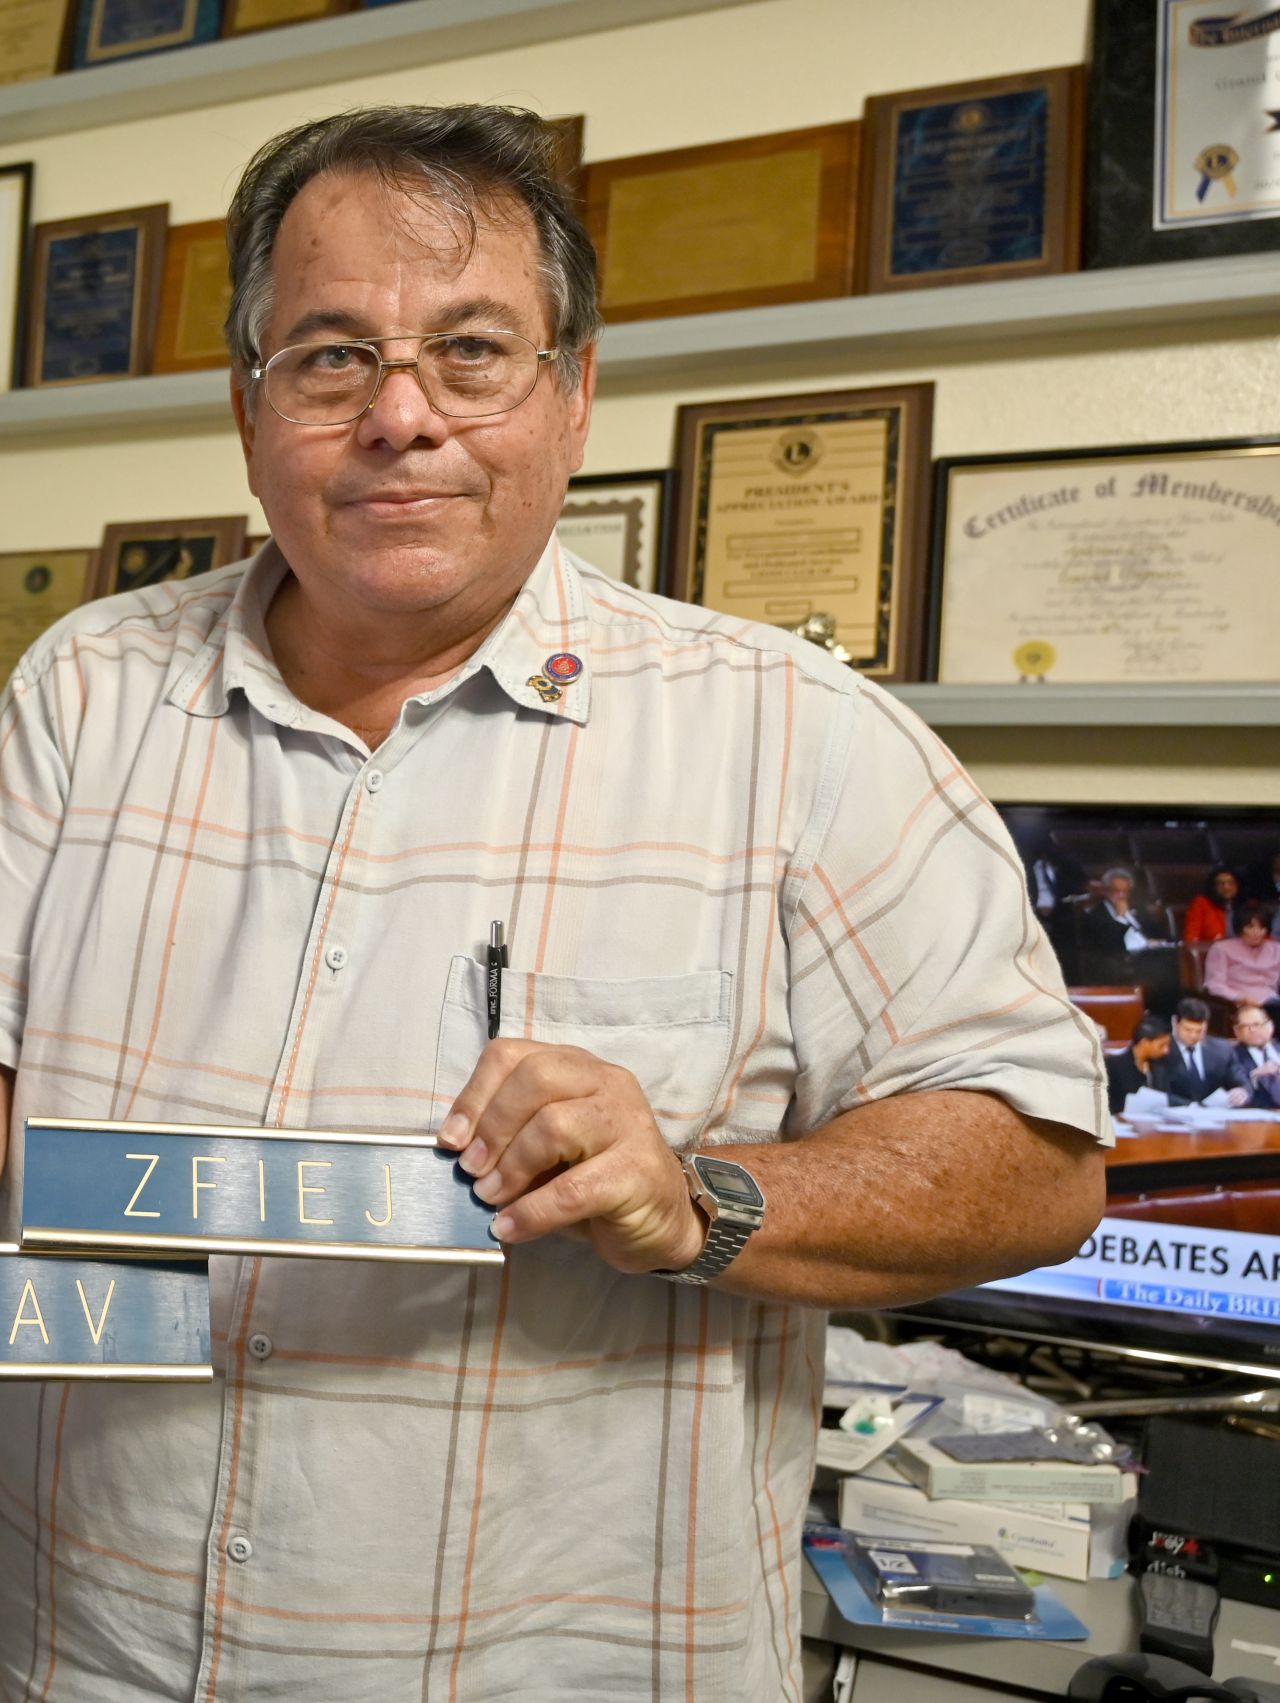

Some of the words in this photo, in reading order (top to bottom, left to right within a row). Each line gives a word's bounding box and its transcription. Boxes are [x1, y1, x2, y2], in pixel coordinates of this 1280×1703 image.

[743, 481, 851, 498] PRESIDENT'S
[715, 497, 821, 513] APPRECIATION
[963, 485, 1081, 540] Certificate
[1094, 475, 1117, 500] of
[1076, 1234, 1229, 1275] DEBATES
[1119, 1280, 1160, 1304] The
[1164, 1289, 1221, 1316] Daily
[1147, 1560, 1186, 1578] dish
